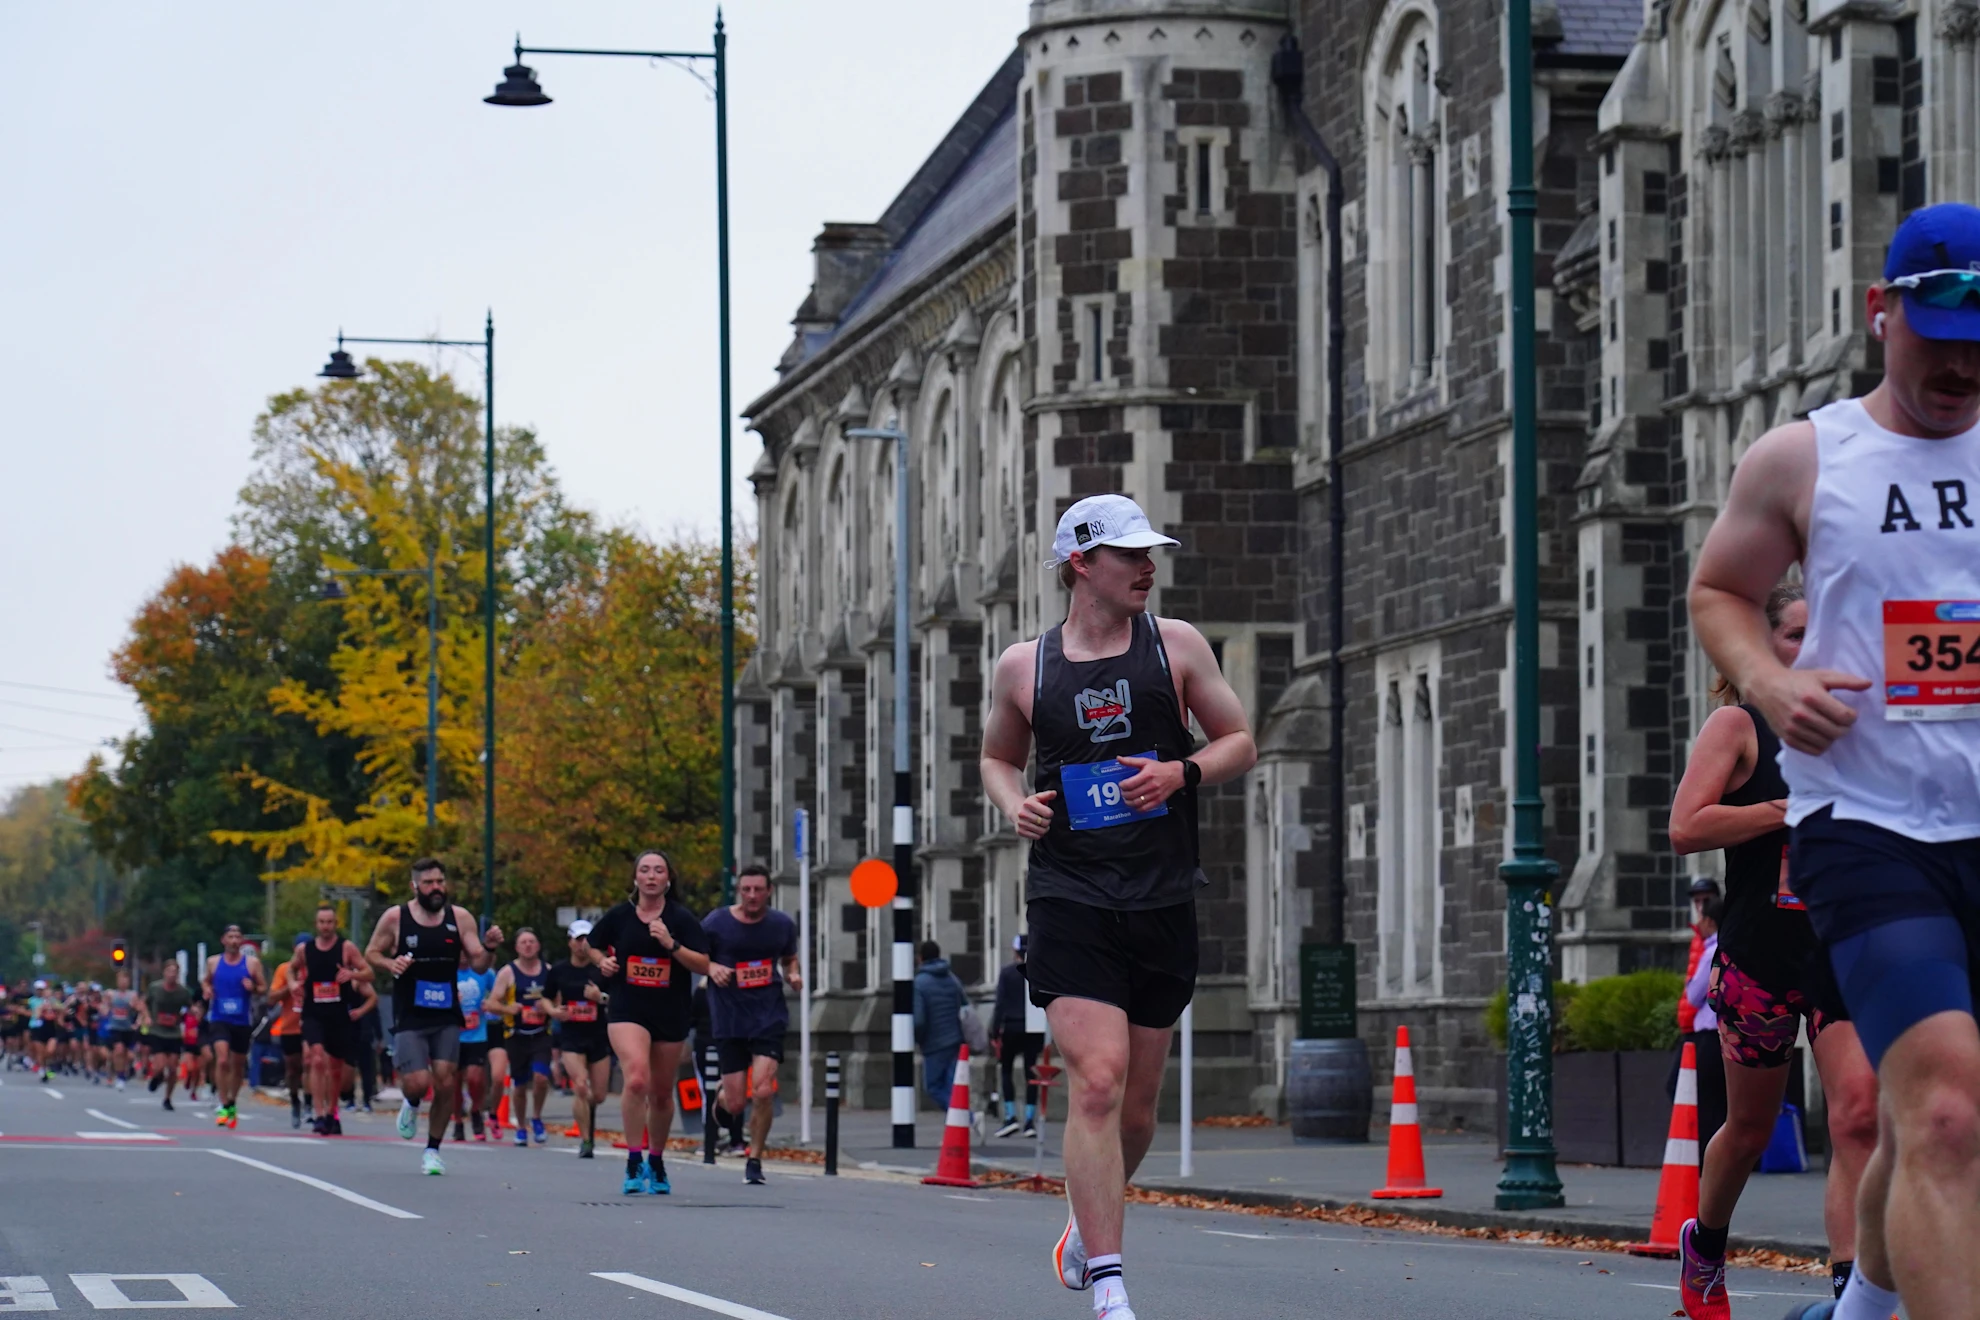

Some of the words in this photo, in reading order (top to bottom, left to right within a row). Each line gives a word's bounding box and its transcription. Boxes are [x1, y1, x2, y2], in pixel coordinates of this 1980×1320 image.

[1880, 479, 1974, 533] AR
[1907, 634, 1980, 672] 354
[1103, 811, 1132, 821] Marathon
[633, 965, 664, 979] 3267
[424, 989, 446, 1002] 586
